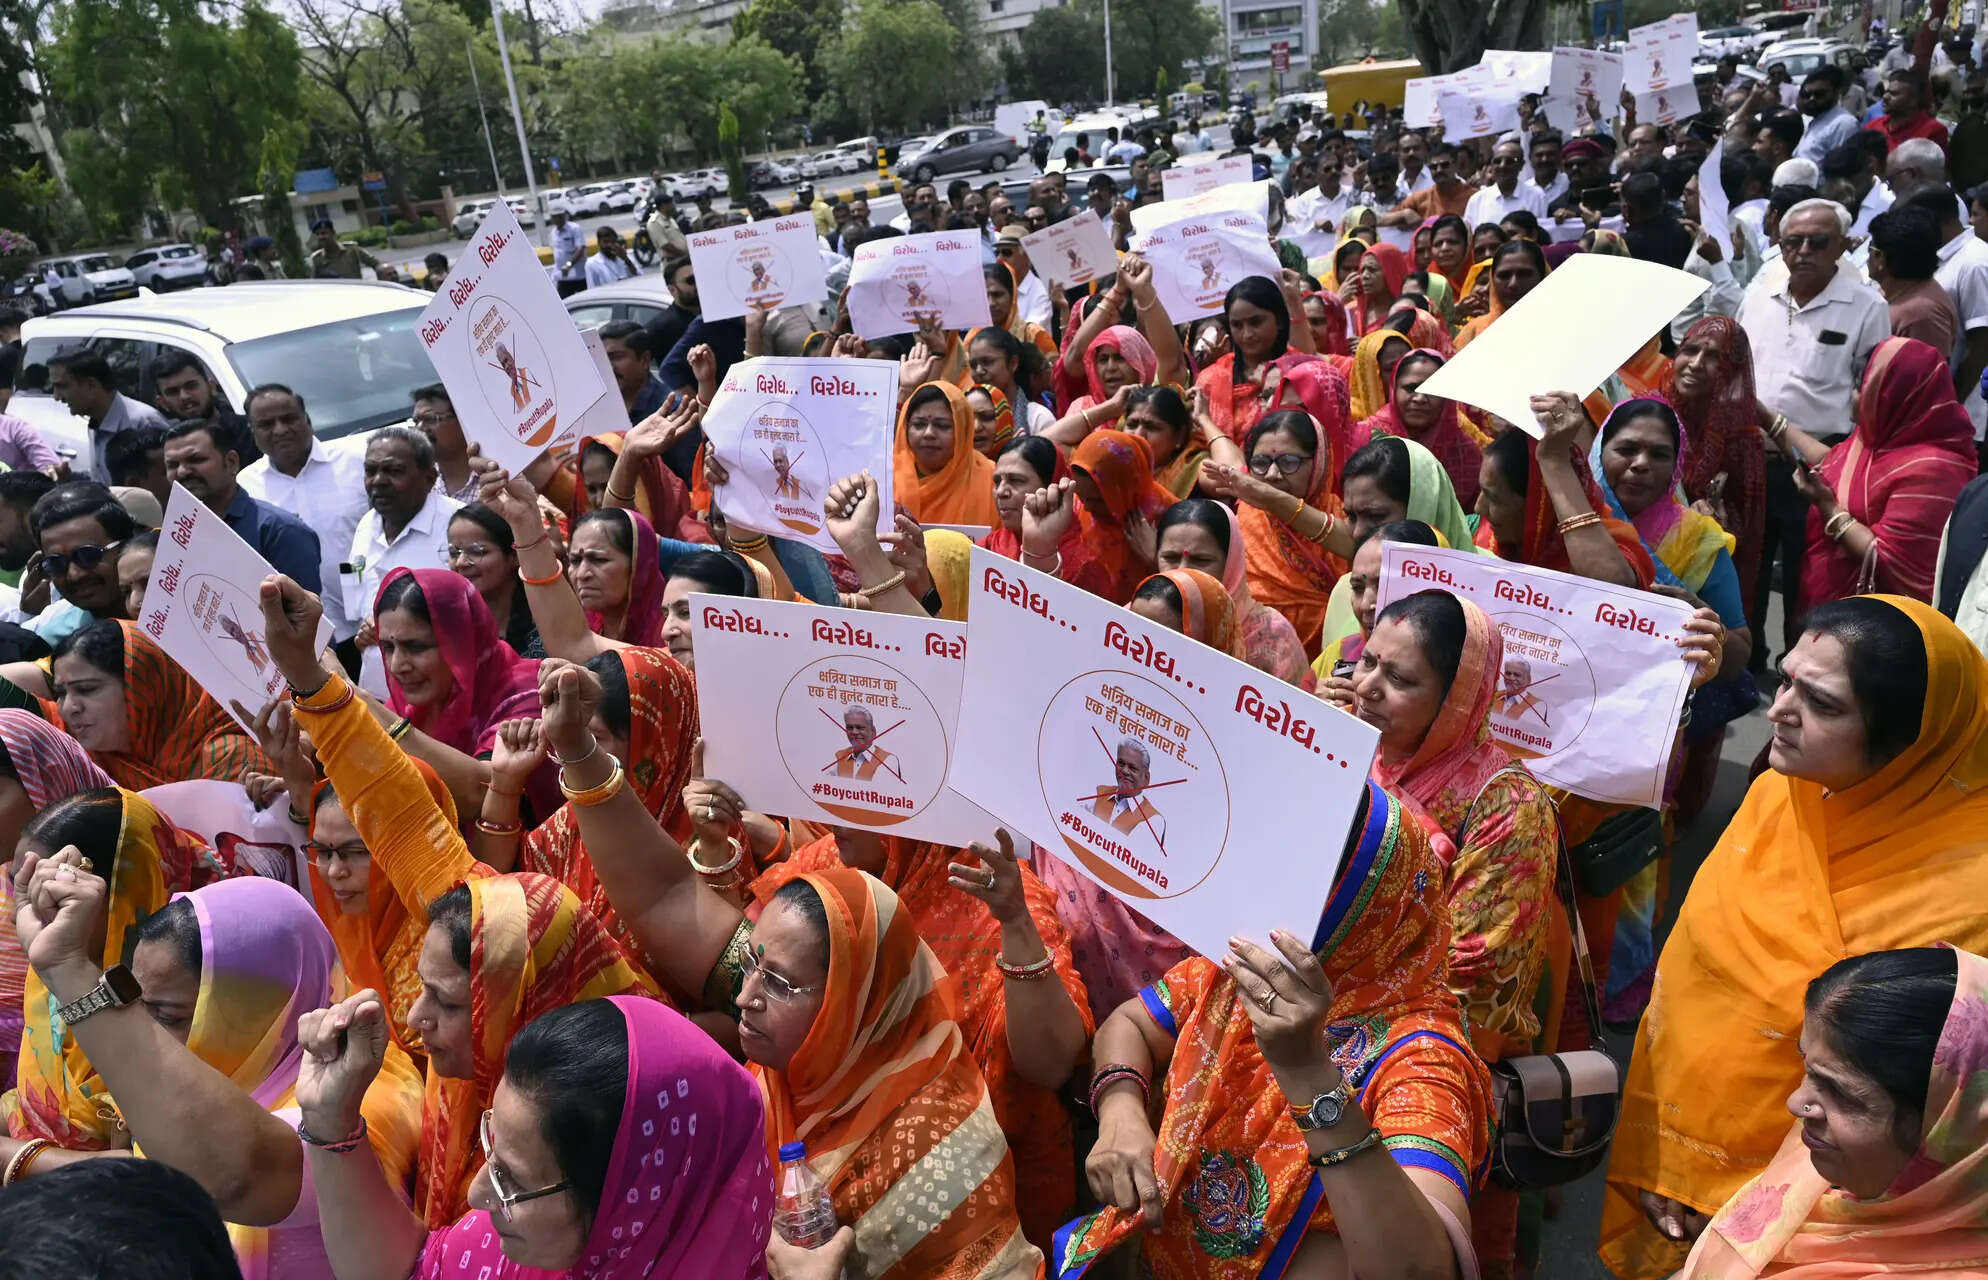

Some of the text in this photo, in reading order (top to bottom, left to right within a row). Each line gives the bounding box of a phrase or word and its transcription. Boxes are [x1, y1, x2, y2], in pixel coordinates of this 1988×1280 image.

[756, 374, 799, 396] વિરોધ...
[811, 375, 878, 397] વિરોધ...
[1401, 560, 1679, 642] વિરોધ... વિરોધ... વિરોધ...
[703, 607, 967, 660] વિરોધ... વિરોધ... વિરો
[1518, 628, 1548, 645] समाज
[1549, 637, 1562, 649] का
[819, 669, 898, 692] क्षत्रिय समाज का
[983, 567, 1349, 769] વિરોધ... વિરોધ... વિરોધ...
[808, 685, 825, 697] एक
[827, 685, 837, 700] ही
[840, 689, 865, 704] बुलंद
[865, 693, 888, 707] नारा
[1101, 684, 1191, 741] क्षत्रिय समाज का
[1085, 695, 1104, 715] एक
[1105, 705, 1118, 724] ही
[1119, 713, 1147, 740] बुलंद
[1148, 729, 1176, 756] नारा
[1490, 722, 1552, 750] cuttRupala
[812, 783, 914, 810] #BoycuttRupala
[1060, 811, 1169, 890] #BoycuttRupala
